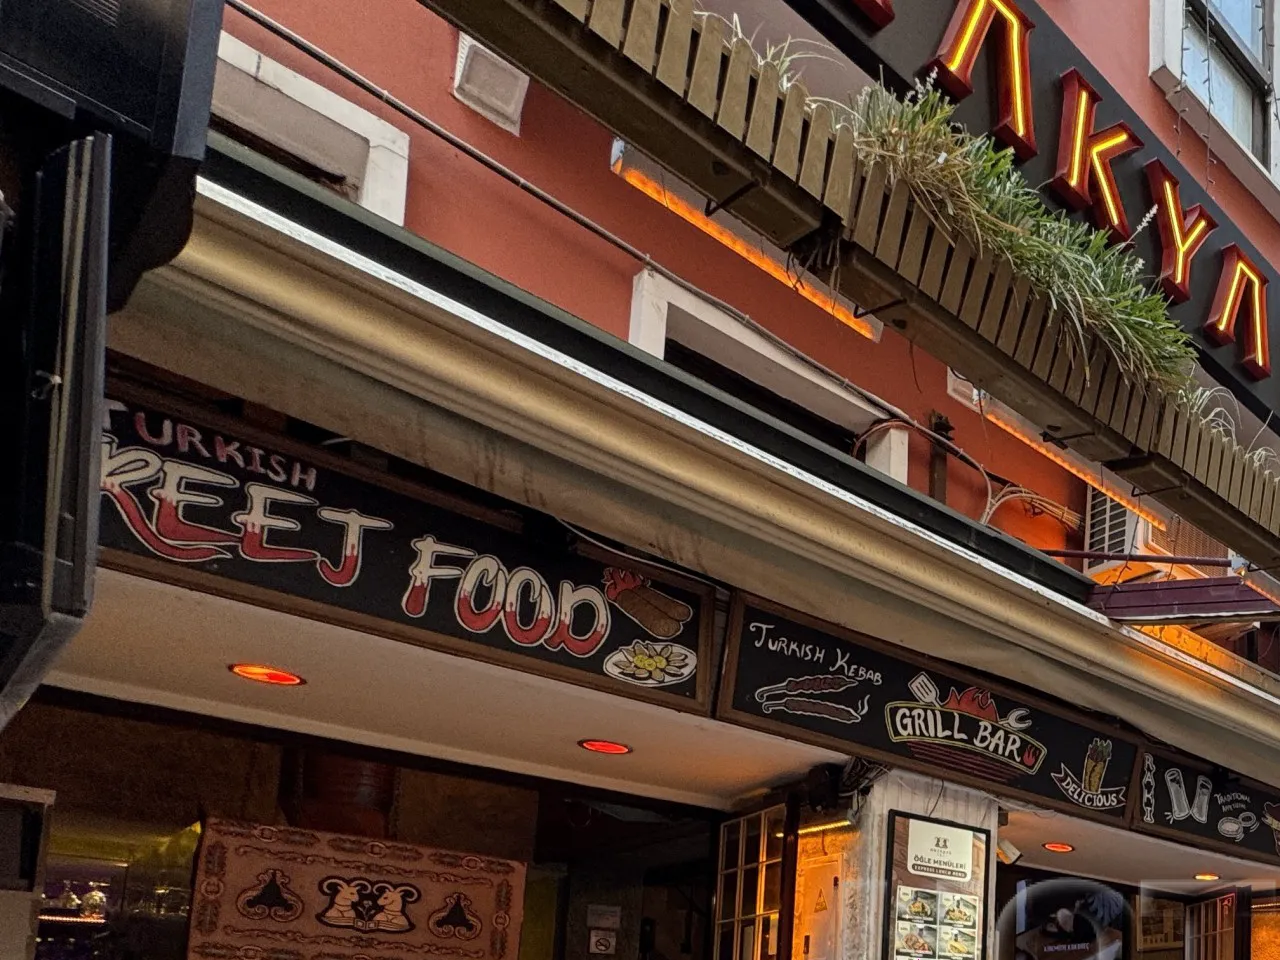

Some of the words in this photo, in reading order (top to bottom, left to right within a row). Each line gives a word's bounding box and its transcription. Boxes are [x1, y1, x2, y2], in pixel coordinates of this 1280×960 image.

[852, 0, 1271, 380] AKYA
[101, 437, 394, 589] REET
[401, 534, 612, 659] FOOD
[895, 707, 968, 740] GRILL
[973, 721, 1022, 763] BAR
[1061, 775, 1119, 807] DELICIOUS
[1142, 753, 1156, 824] RAKI
